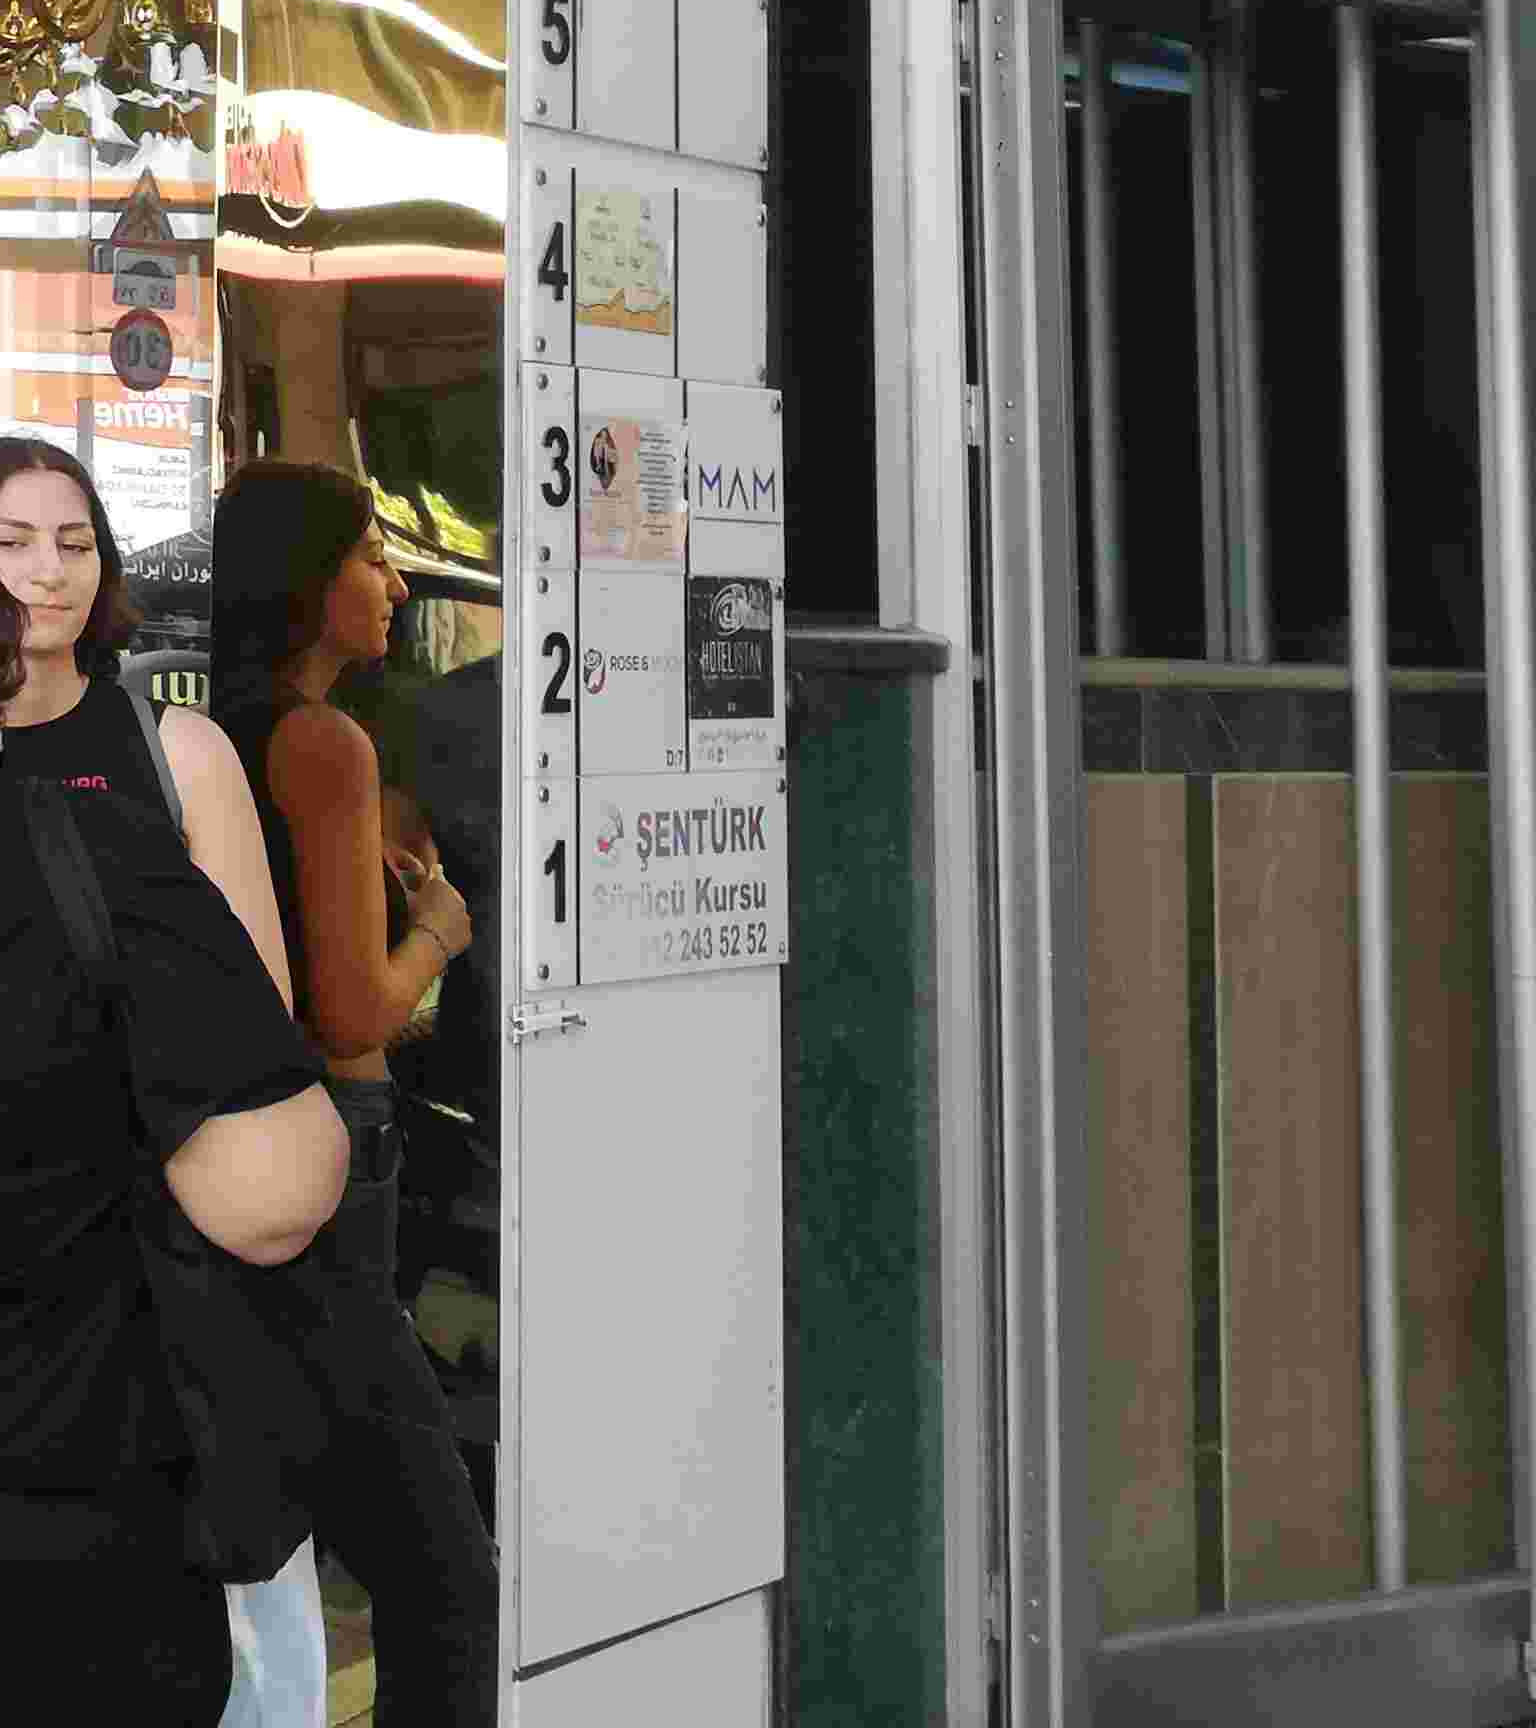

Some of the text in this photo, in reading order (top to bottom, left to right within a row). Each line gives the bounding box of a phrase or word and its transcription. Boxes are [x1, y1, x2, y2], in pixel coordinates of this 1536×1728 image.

[537, 221, 569, 302] 4
[540, 426, 571, 508] 3
[540, 631, 572, 715] 2
[609, 655, 639, 672] ROSE
[635, 796, 767, 872] ŞENTÜRK
[543, 839, 567, 923] 1
[695, 876, 767, 916] Kursu
[679, 924, 714, 962] 243
[719, 923, 741, 959] 52
[746, 920, 768, 956] 52
